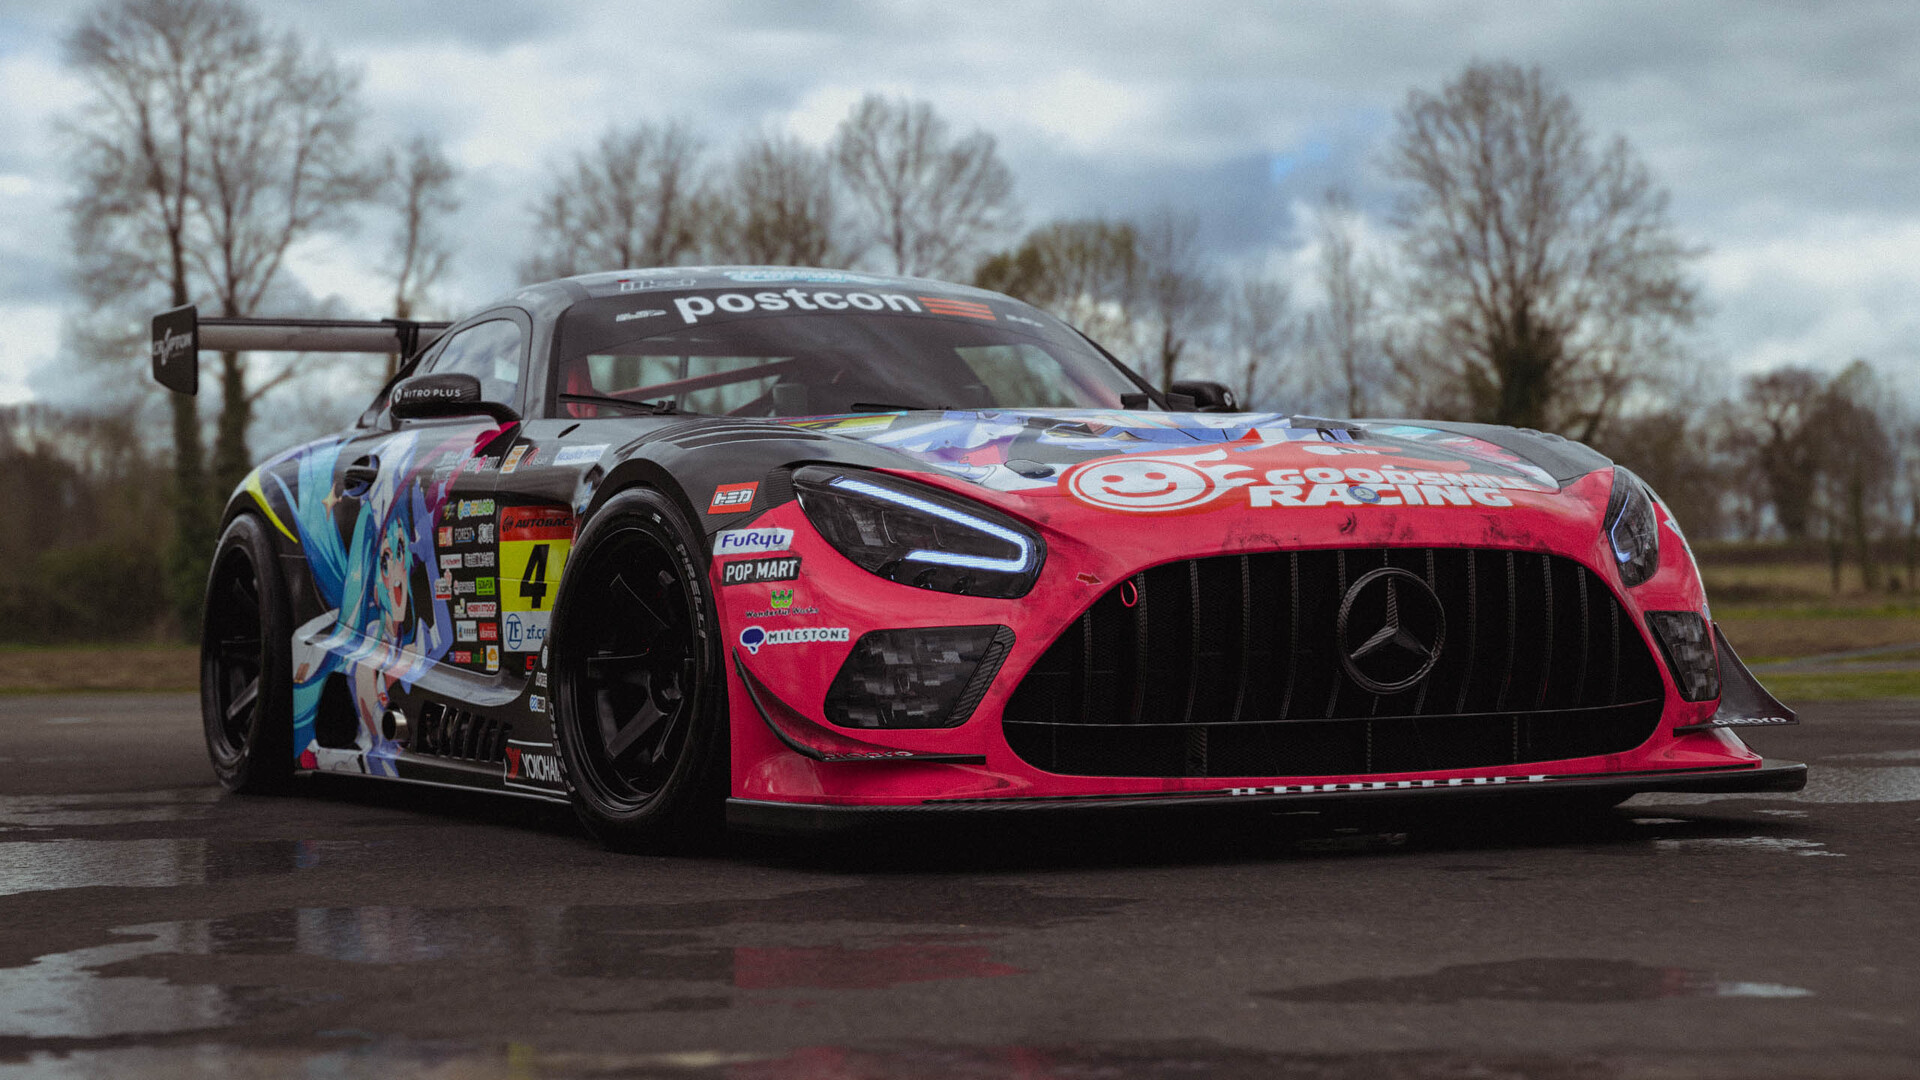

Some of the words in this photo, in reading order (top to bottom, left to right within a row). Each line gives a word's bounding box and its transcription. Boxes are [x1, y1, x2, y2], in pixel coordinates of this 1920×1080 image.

[673, 288, 922, 324] postcon
[403, 389, 431, 398] NITRO
[433, 388, 461, 397] PLUS
[712, 489, 755, 506] トミカ
[1249, 484, 1513, 507] RACING
[515, 517, 575, 528] AUTOBAC
[722, 532, 785, 549] FuRyu
[519, 544, 550, 609] 4
[725, 563, 753, 583] POP
[756, 560, 798, 579] MART
[676, 543, 706, 639] PIRELLI
[768, 630, 849, 642] MILESTONE
[521, 753, 563, 783] YOKOHAM
